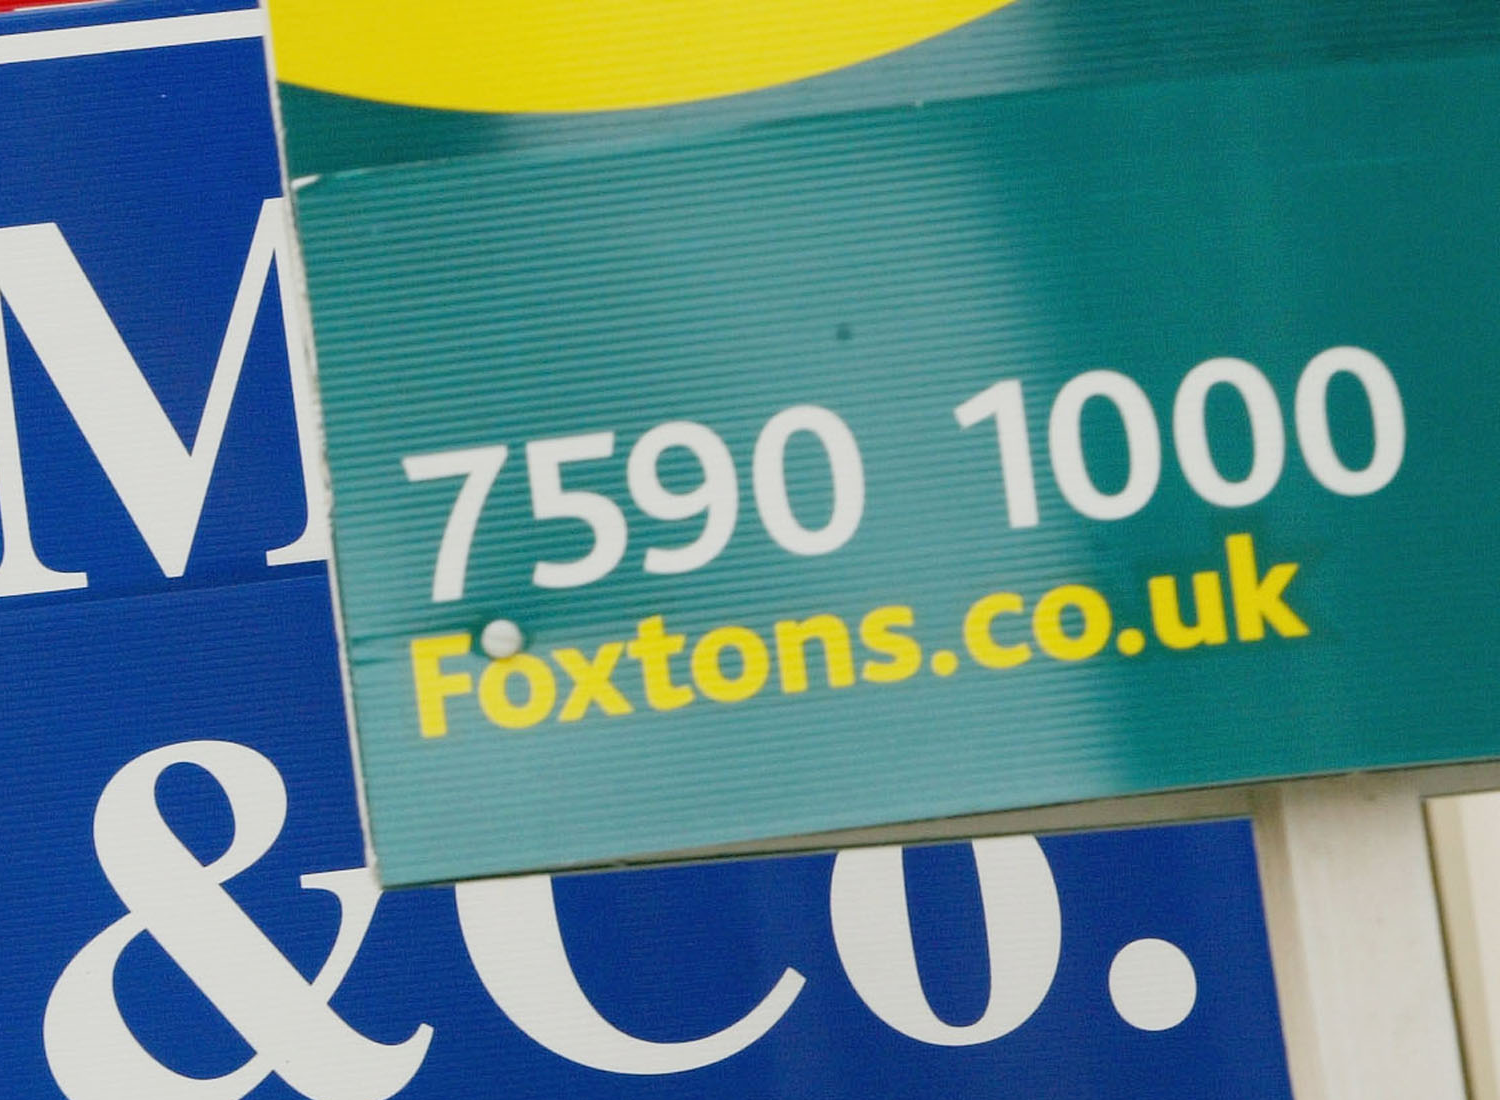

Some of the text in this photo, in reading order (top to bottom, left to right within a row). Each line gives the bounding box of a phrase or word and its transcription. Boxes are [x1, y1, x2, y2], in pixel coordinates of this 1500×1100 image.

[402, 346, 1405, 602] 7590 1000
[409, 533, 1309, 739] Foxtons.co.uk
